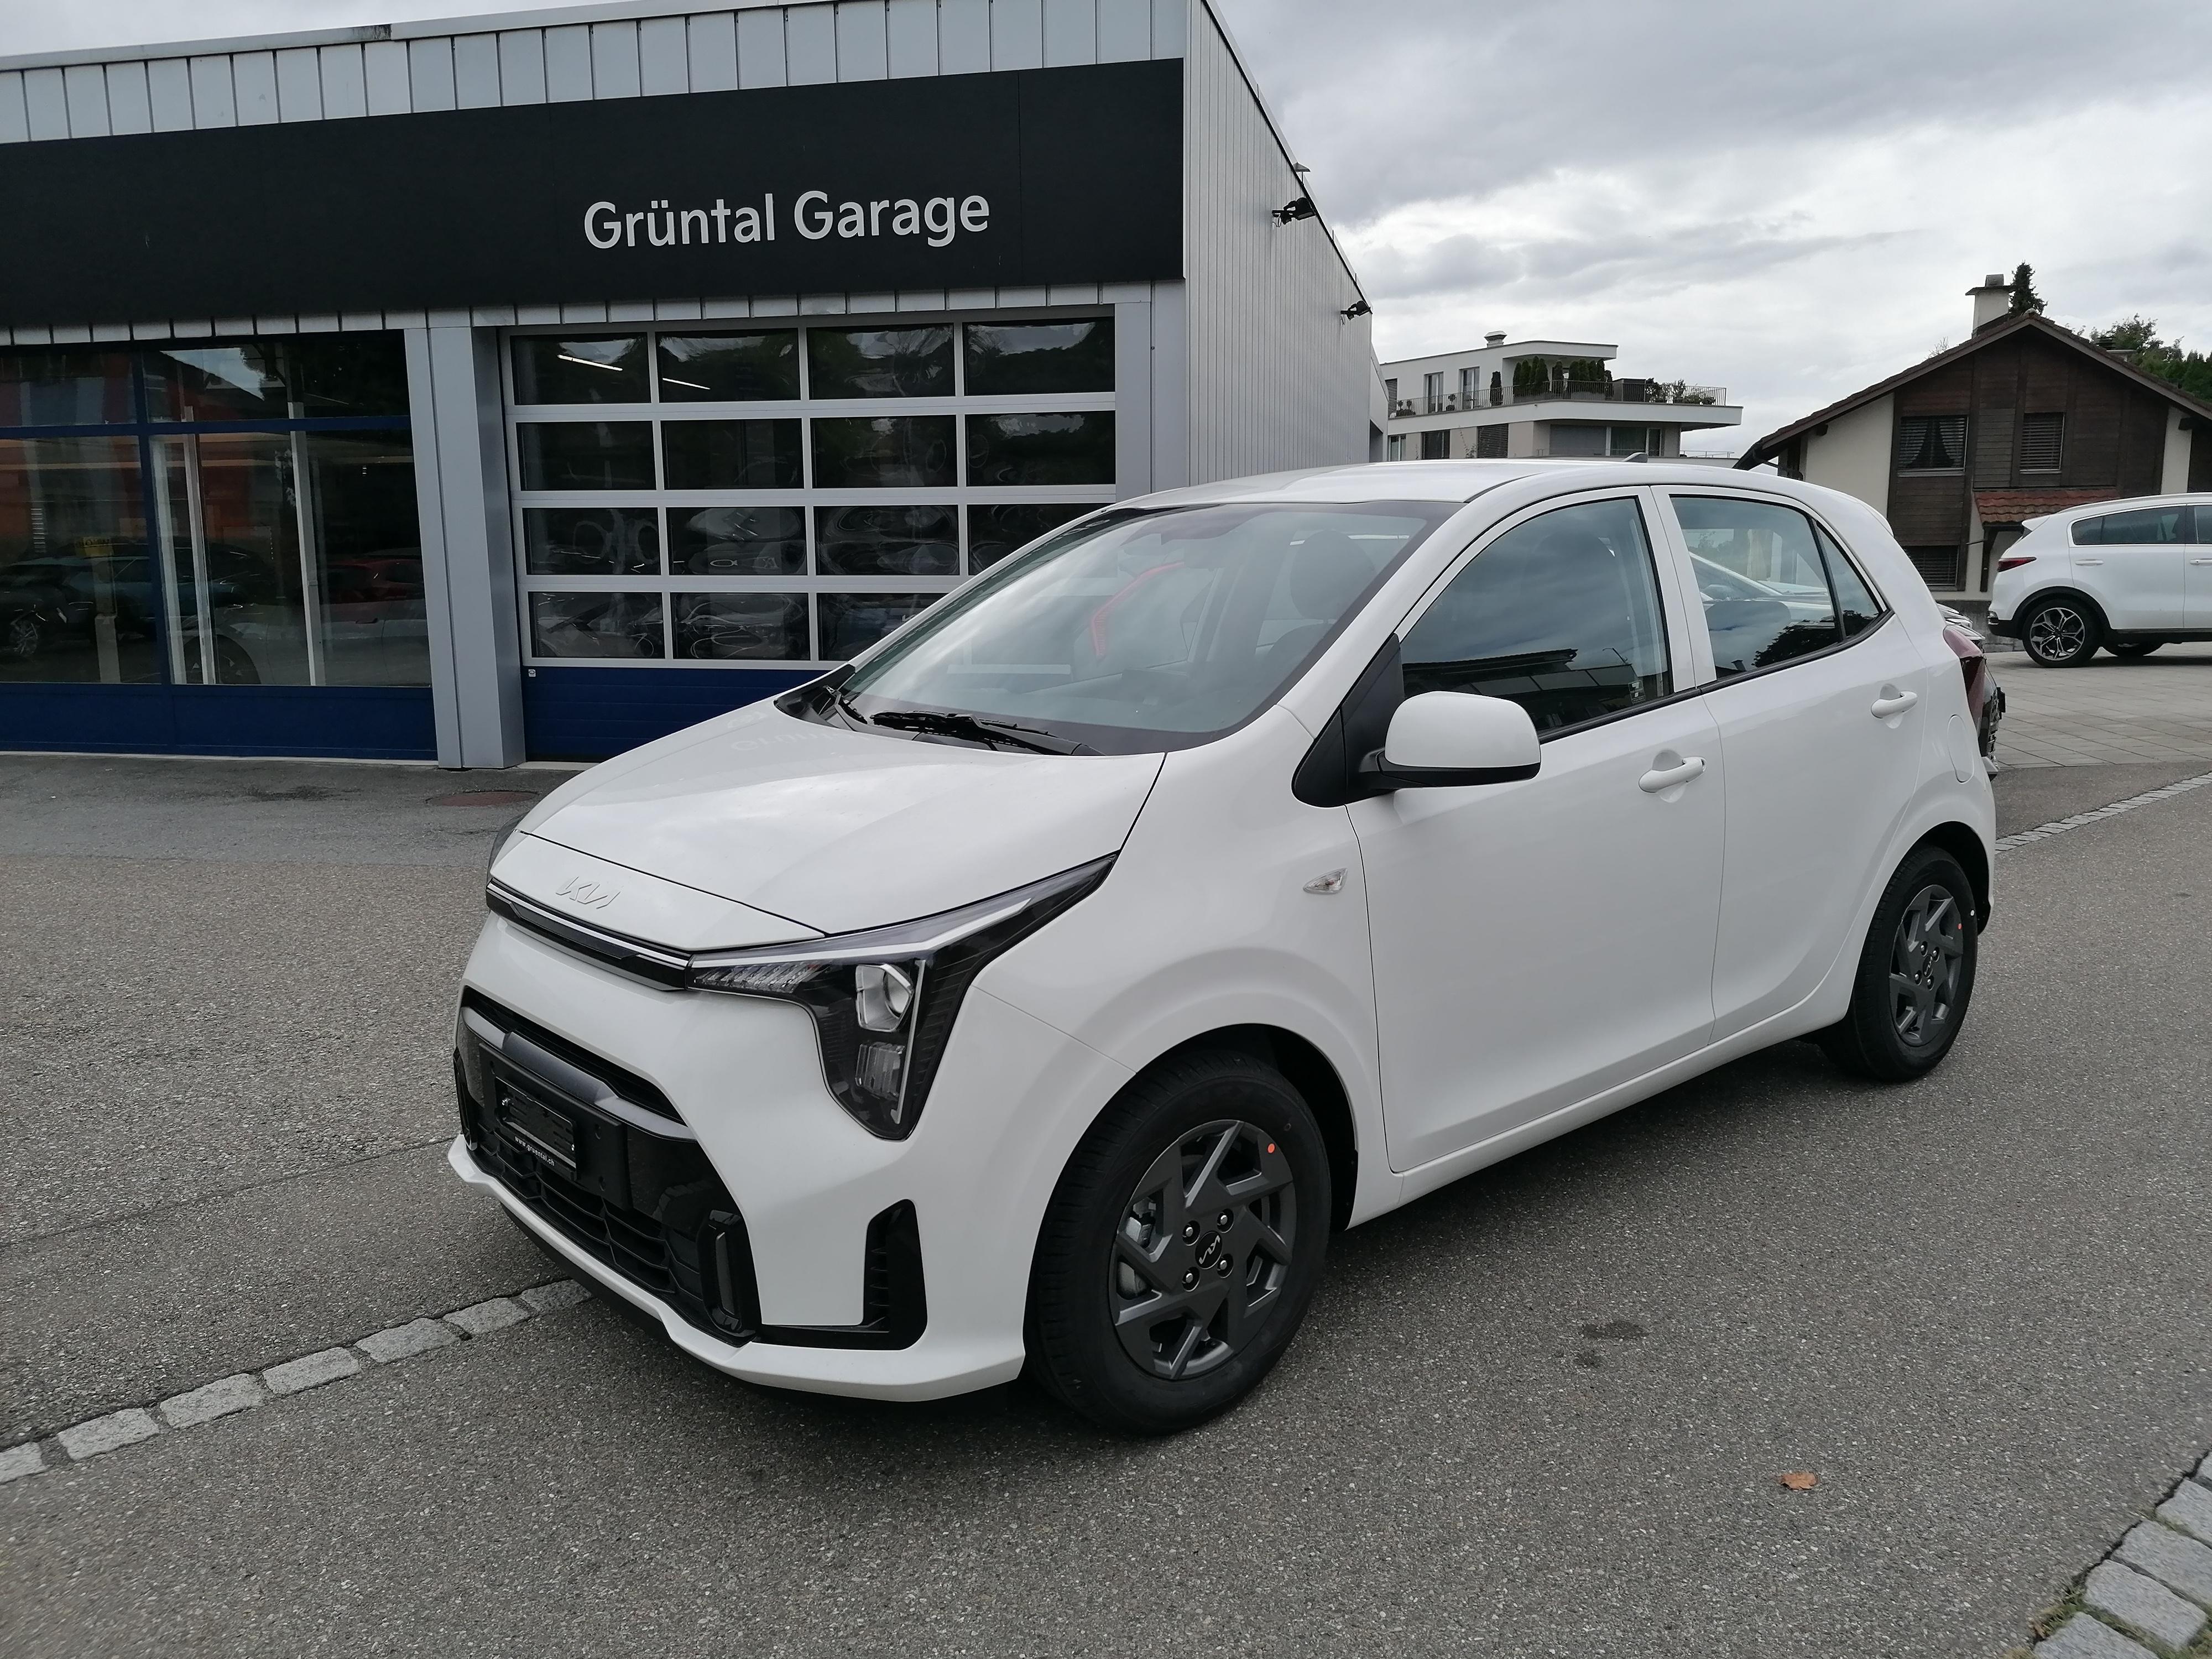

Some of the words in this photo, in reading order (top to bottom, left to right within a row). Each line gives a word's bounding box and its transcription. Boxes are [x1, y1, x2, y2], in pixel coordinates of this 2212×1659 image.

[584, 193, 775, 249] Grüntal
[794, 190, 989, 247] Garage
[556, 876, 622, 910] KIA
[514, 1136, 555, 1166] www.gruental.ch
